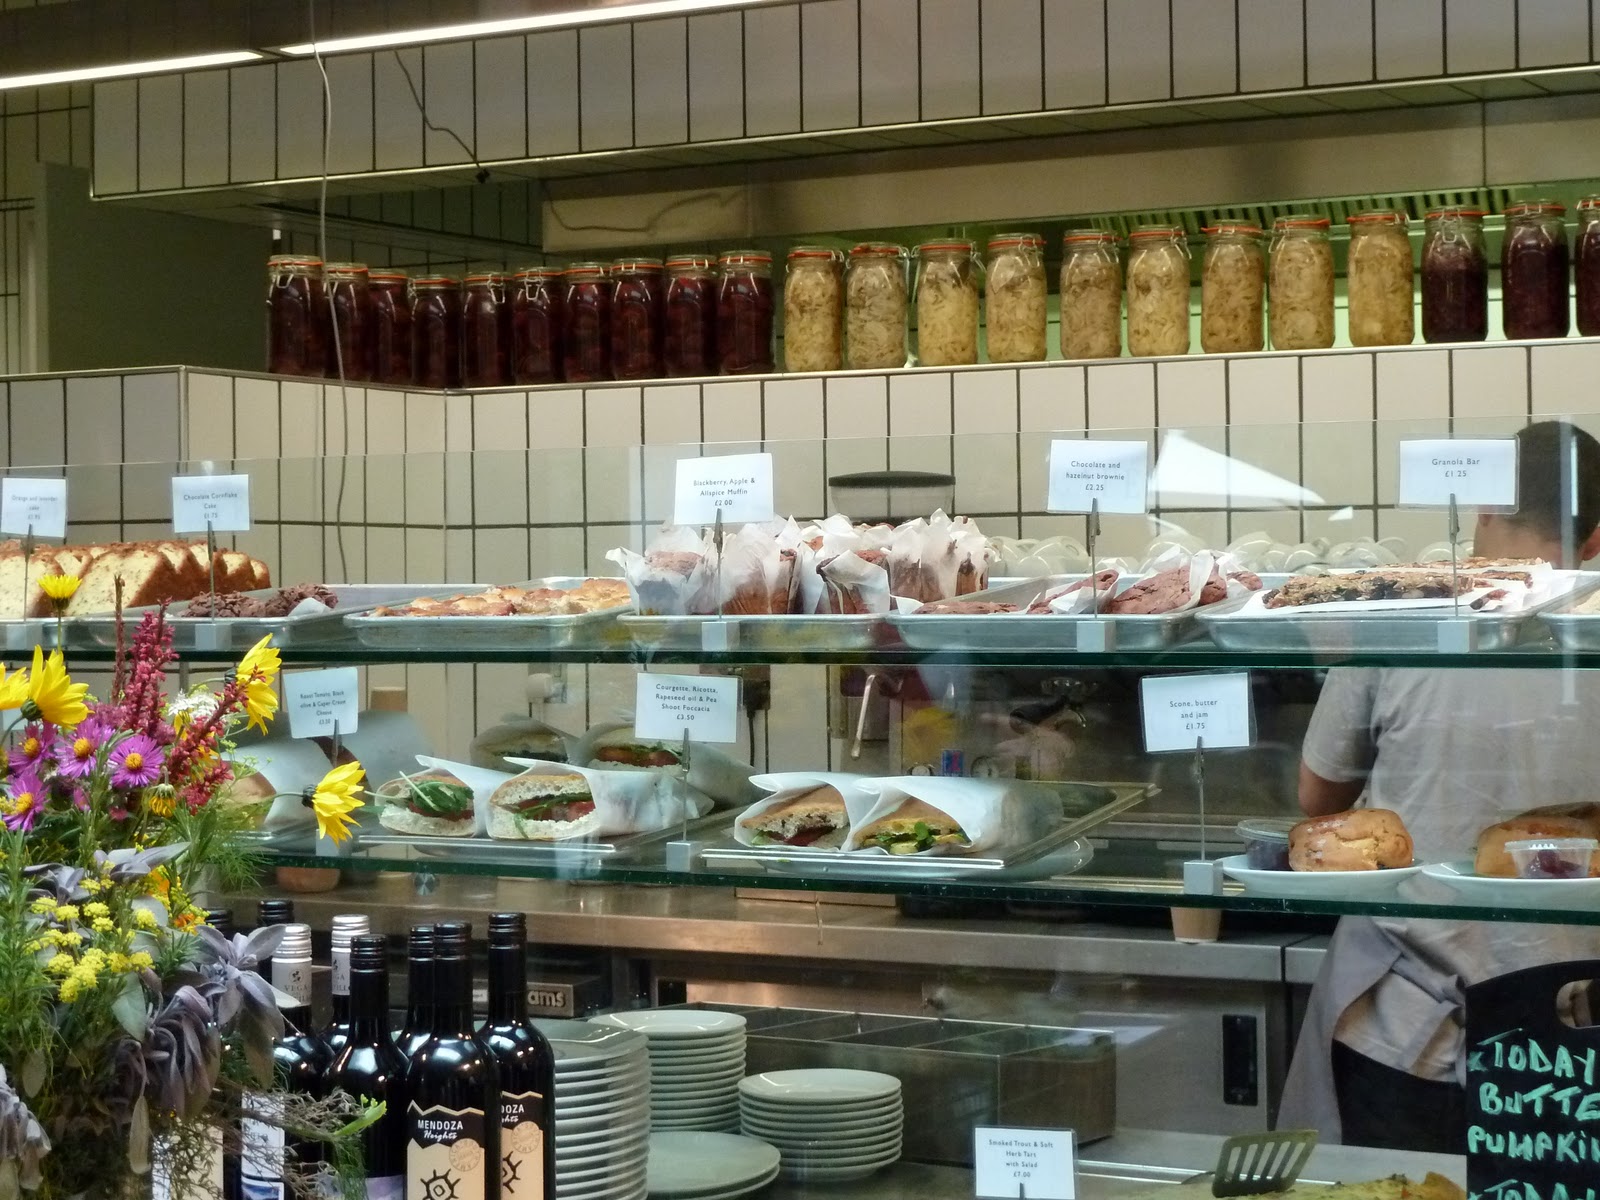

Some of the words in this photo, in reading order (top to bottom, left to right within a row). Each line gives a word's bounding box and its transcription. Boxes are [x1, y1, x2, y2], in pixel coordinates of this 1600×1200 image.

[656, 684, 690, 692] Courgette,
[528, 990, 566, 1008] ams
[1477, 1028, 1596, 1086] TODAY
[418, 1120, 464, 1130] MENDOZA
[423, 1130, 458, 1142] Heights
